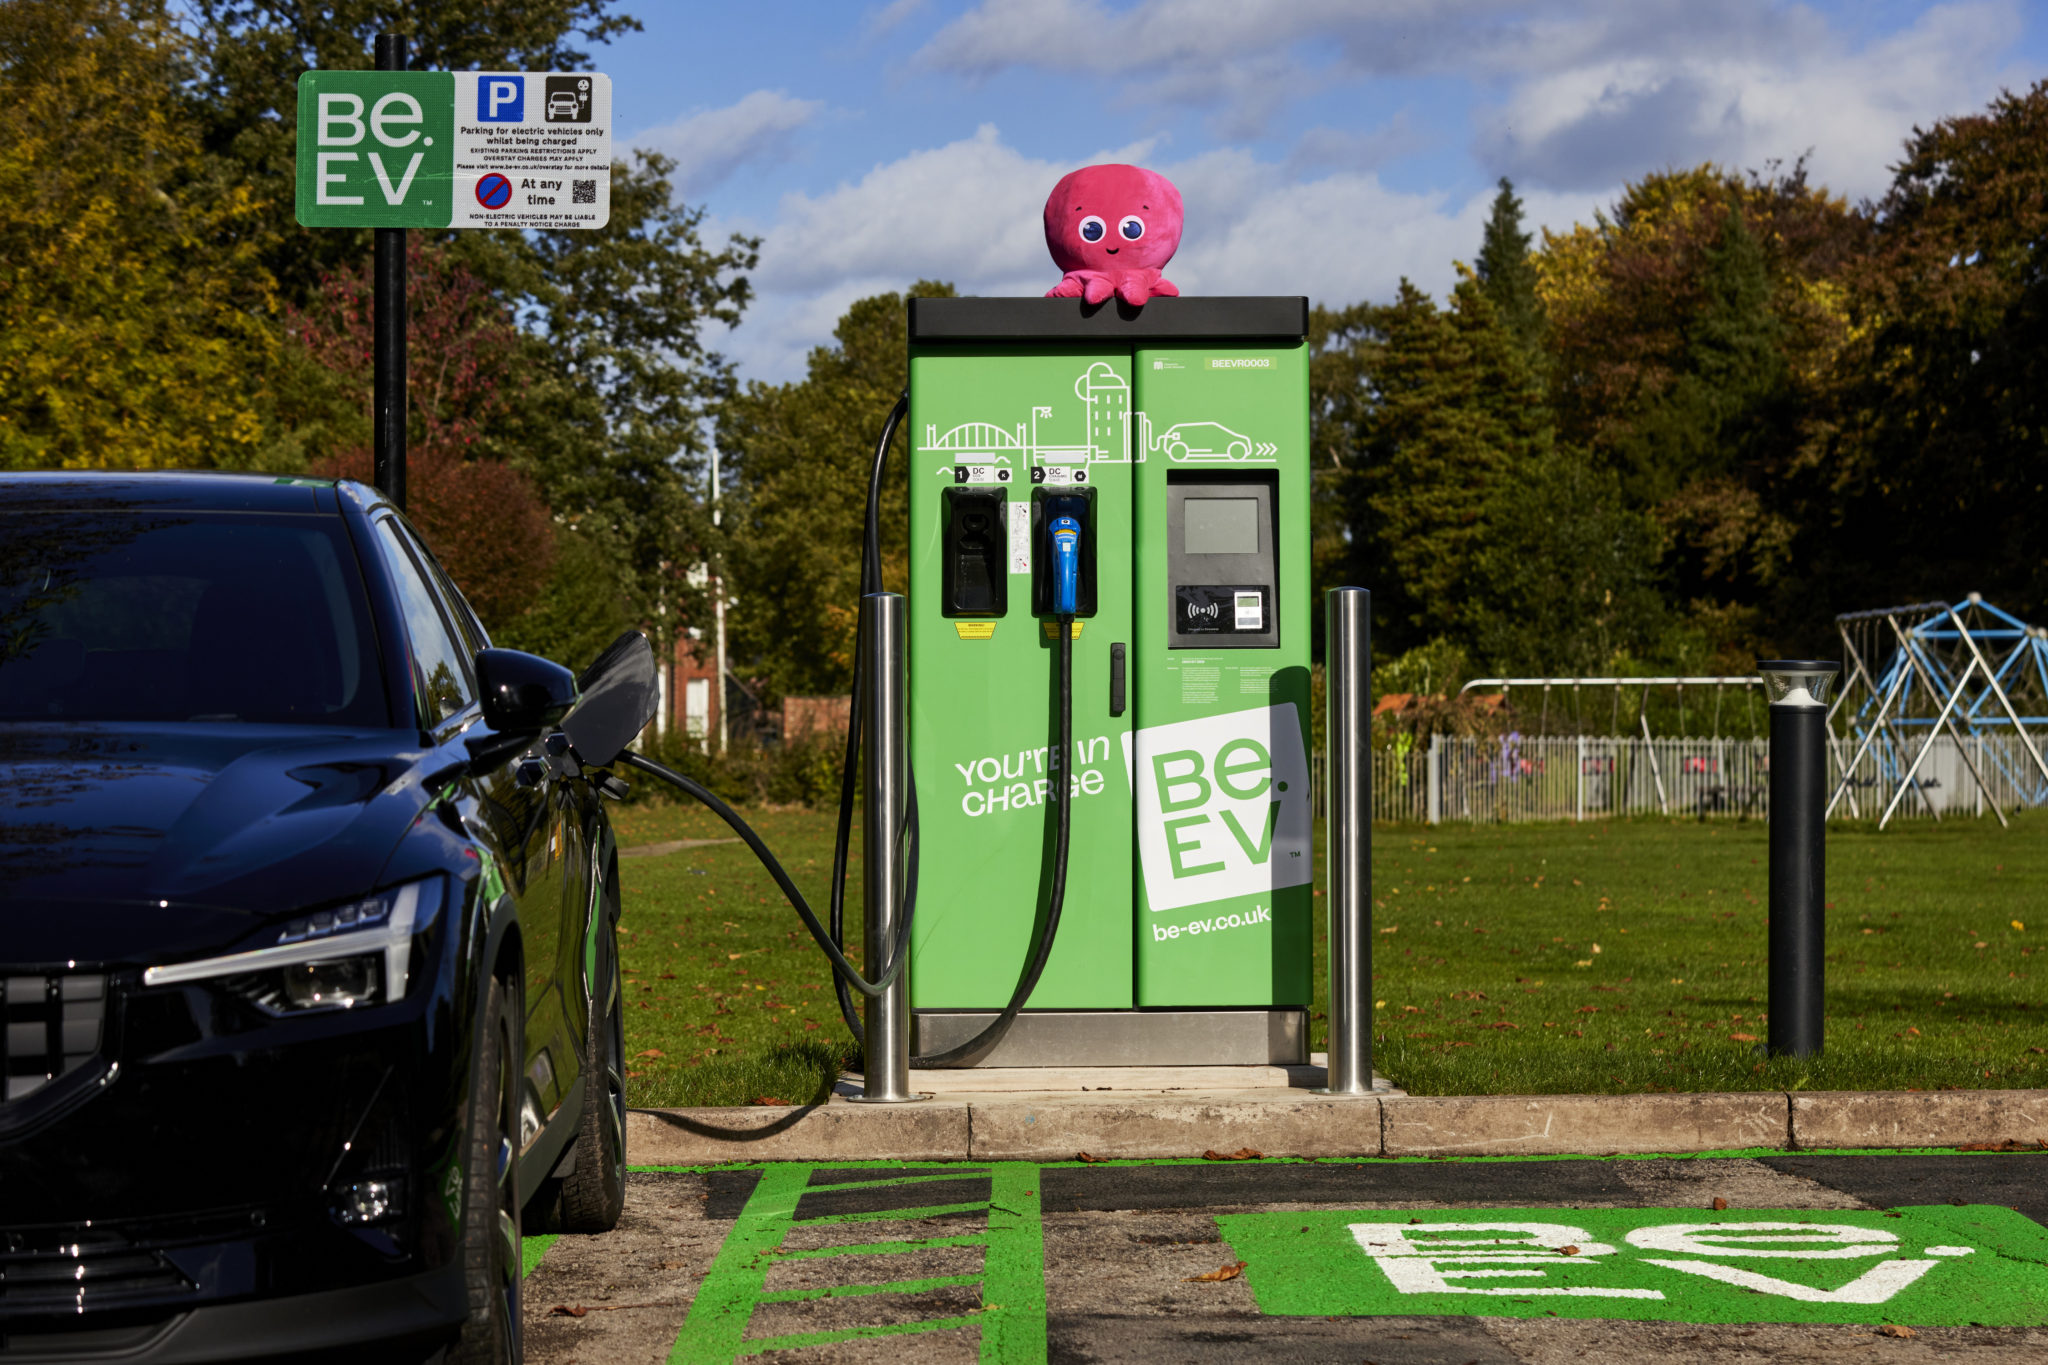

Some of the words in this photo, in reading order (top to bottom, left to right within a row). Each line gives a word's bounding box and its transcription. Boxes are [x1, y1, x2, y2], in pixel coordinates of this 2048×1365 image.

[489, 81, 517, 118] P
[460, 126, 494, 136] Parking
[496, 126, 509, 135] for
[512, 127, 545, 135] electric
[547, 127, 583, 135] vehicles
[585, 127, 604, 137] only
[486, 137, 513, 145] whilst
[515, 137, 540, 146] being
[542, 138, 578, 146] charged
[316, 152, 425, 206] EV
[521, 178, 536, 189] At
[540, 179, 563, 191] any
[527, 194, 556, 205] time
[957, 470, 963, 479] 1
[972, 467, 985, 475] DC
[1033, 470, 1041, 480] 2
[1048, 467, 1062, 475] DC
[1164, 799, 1282, 880] EV
[1152, 904, 1272, 942] be-ev.co.uk
[1372, 1255, 1941, 1304] EV
